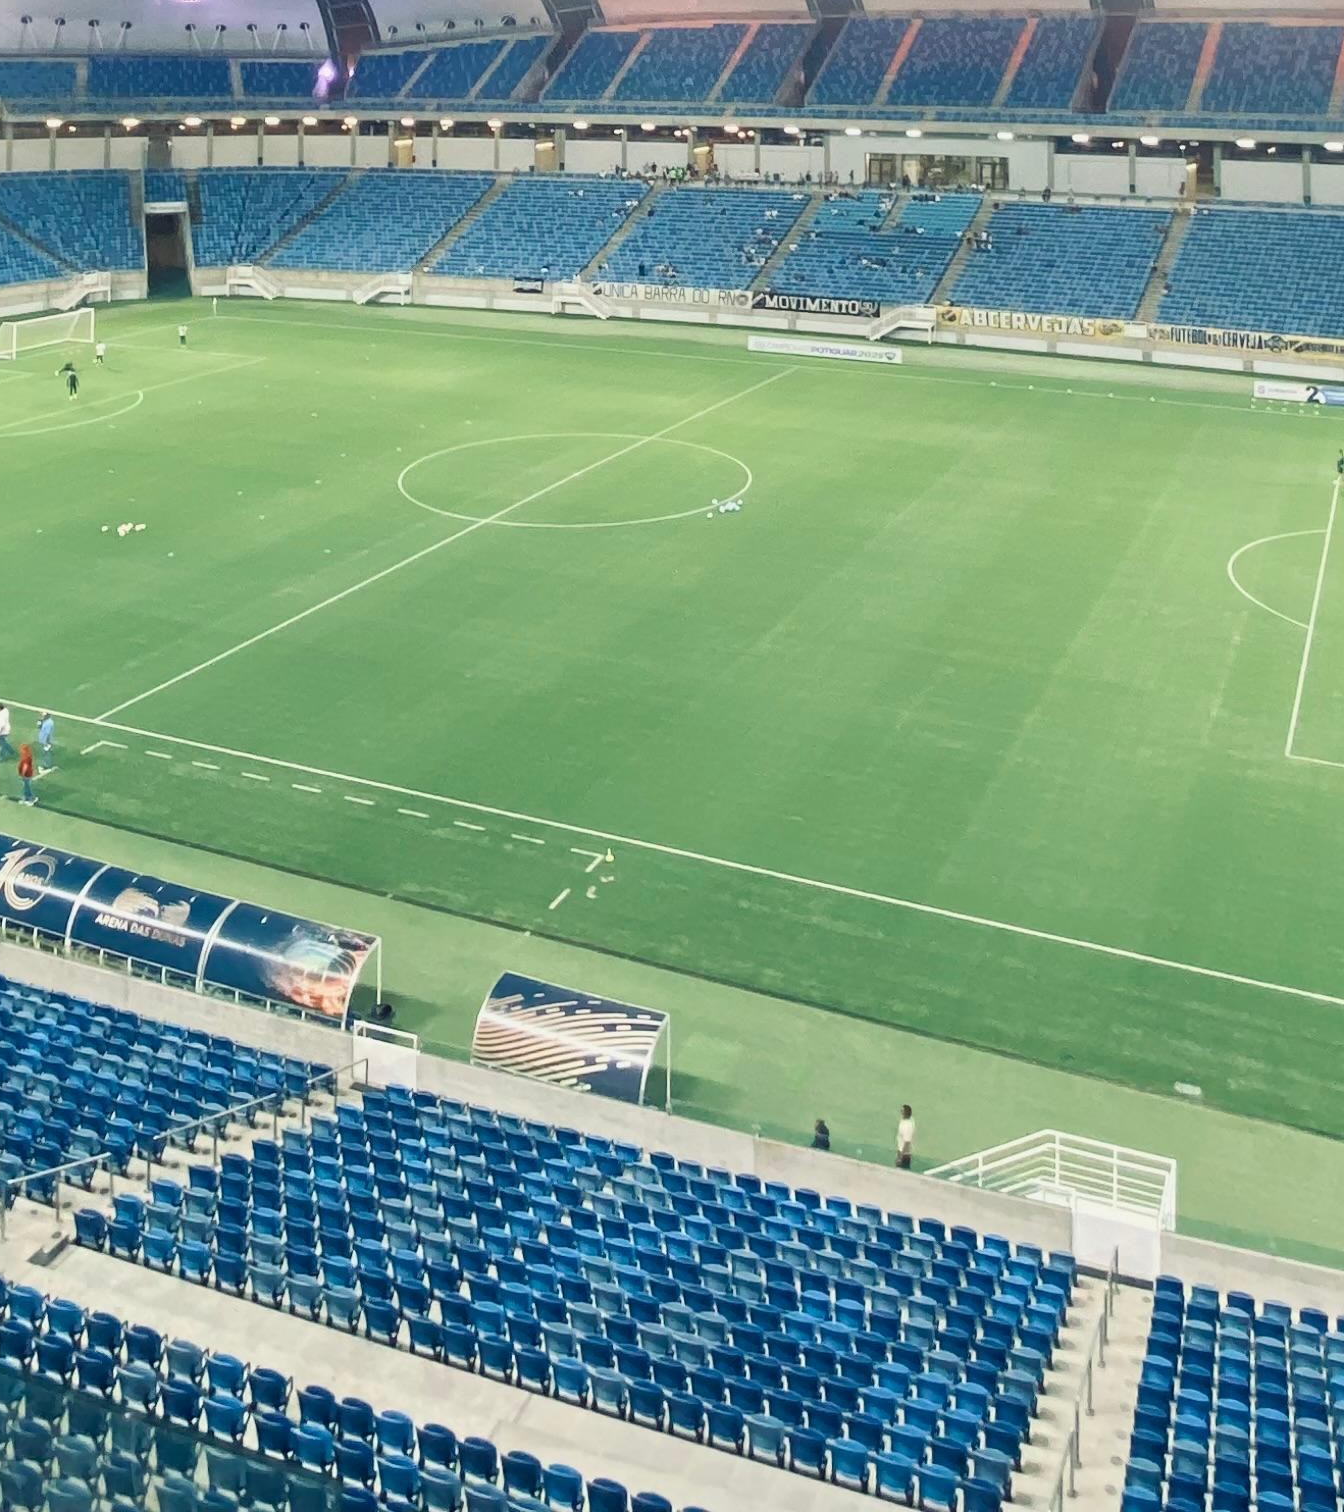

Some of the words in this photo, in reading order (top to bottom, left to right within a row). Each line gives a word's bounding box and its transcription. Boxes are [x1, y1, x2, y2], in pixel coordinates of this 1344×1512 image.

[644, 285, 686, 302] BARRA
[692, 288, 710, 304] DO
[718, 291, 736, 306] RN
[765, 294, 859, 315] MOVIMENTO
[959, 308, 1095, 336] ABCERVEJAS
[1170, 326, 1207, 345] FUTEBOL
[1222, 330, 1265, 350] CERVEJA
[94, 912, 129, 932] ARENA
[129, 921, 150, 938] DAS
